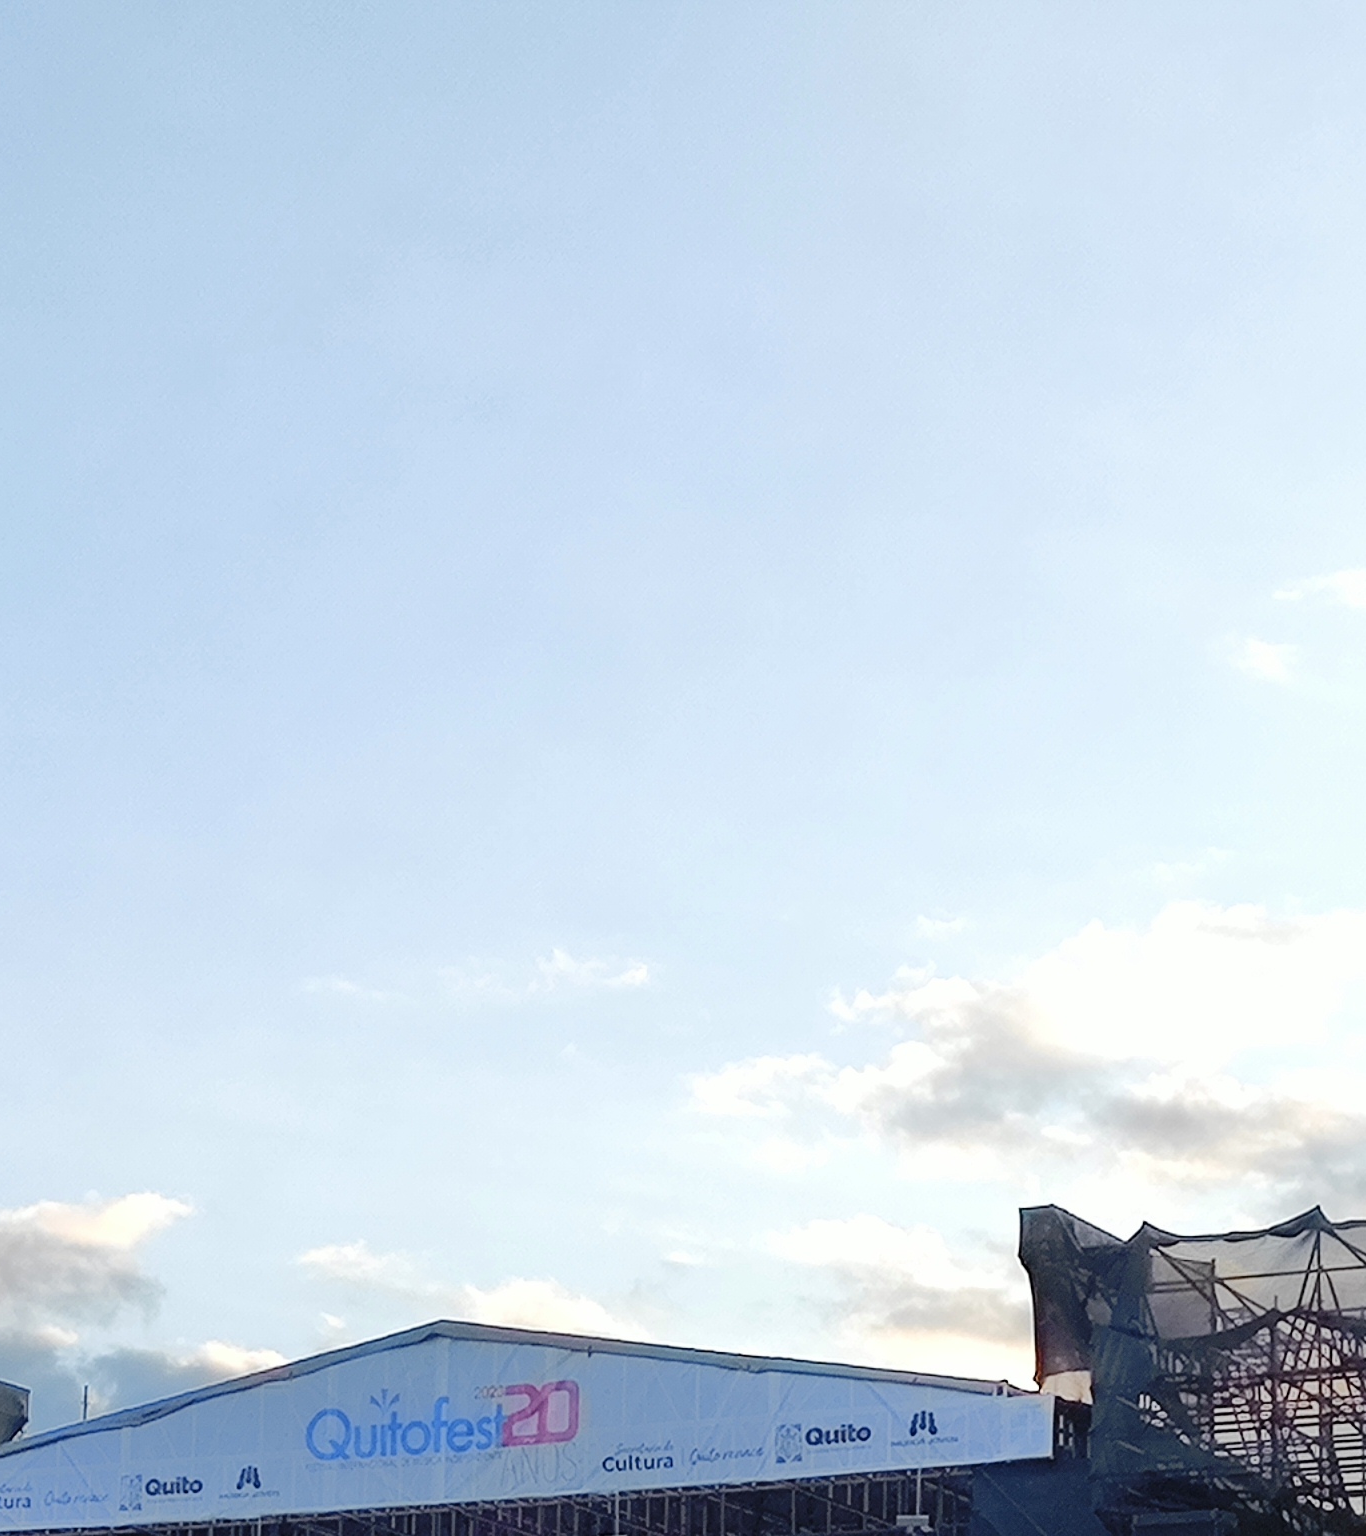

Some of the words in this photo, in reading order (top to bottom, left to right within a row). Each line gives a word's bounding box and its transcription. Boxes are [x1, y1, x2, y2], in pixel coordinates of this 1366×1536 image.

[306, 1390, 507, 1460] Quitofest
[805, 1424, 871, 1446] Quito
[602, 1454, 674, 1472] Cultura
[145, 1476, 203, 1496] Quito
